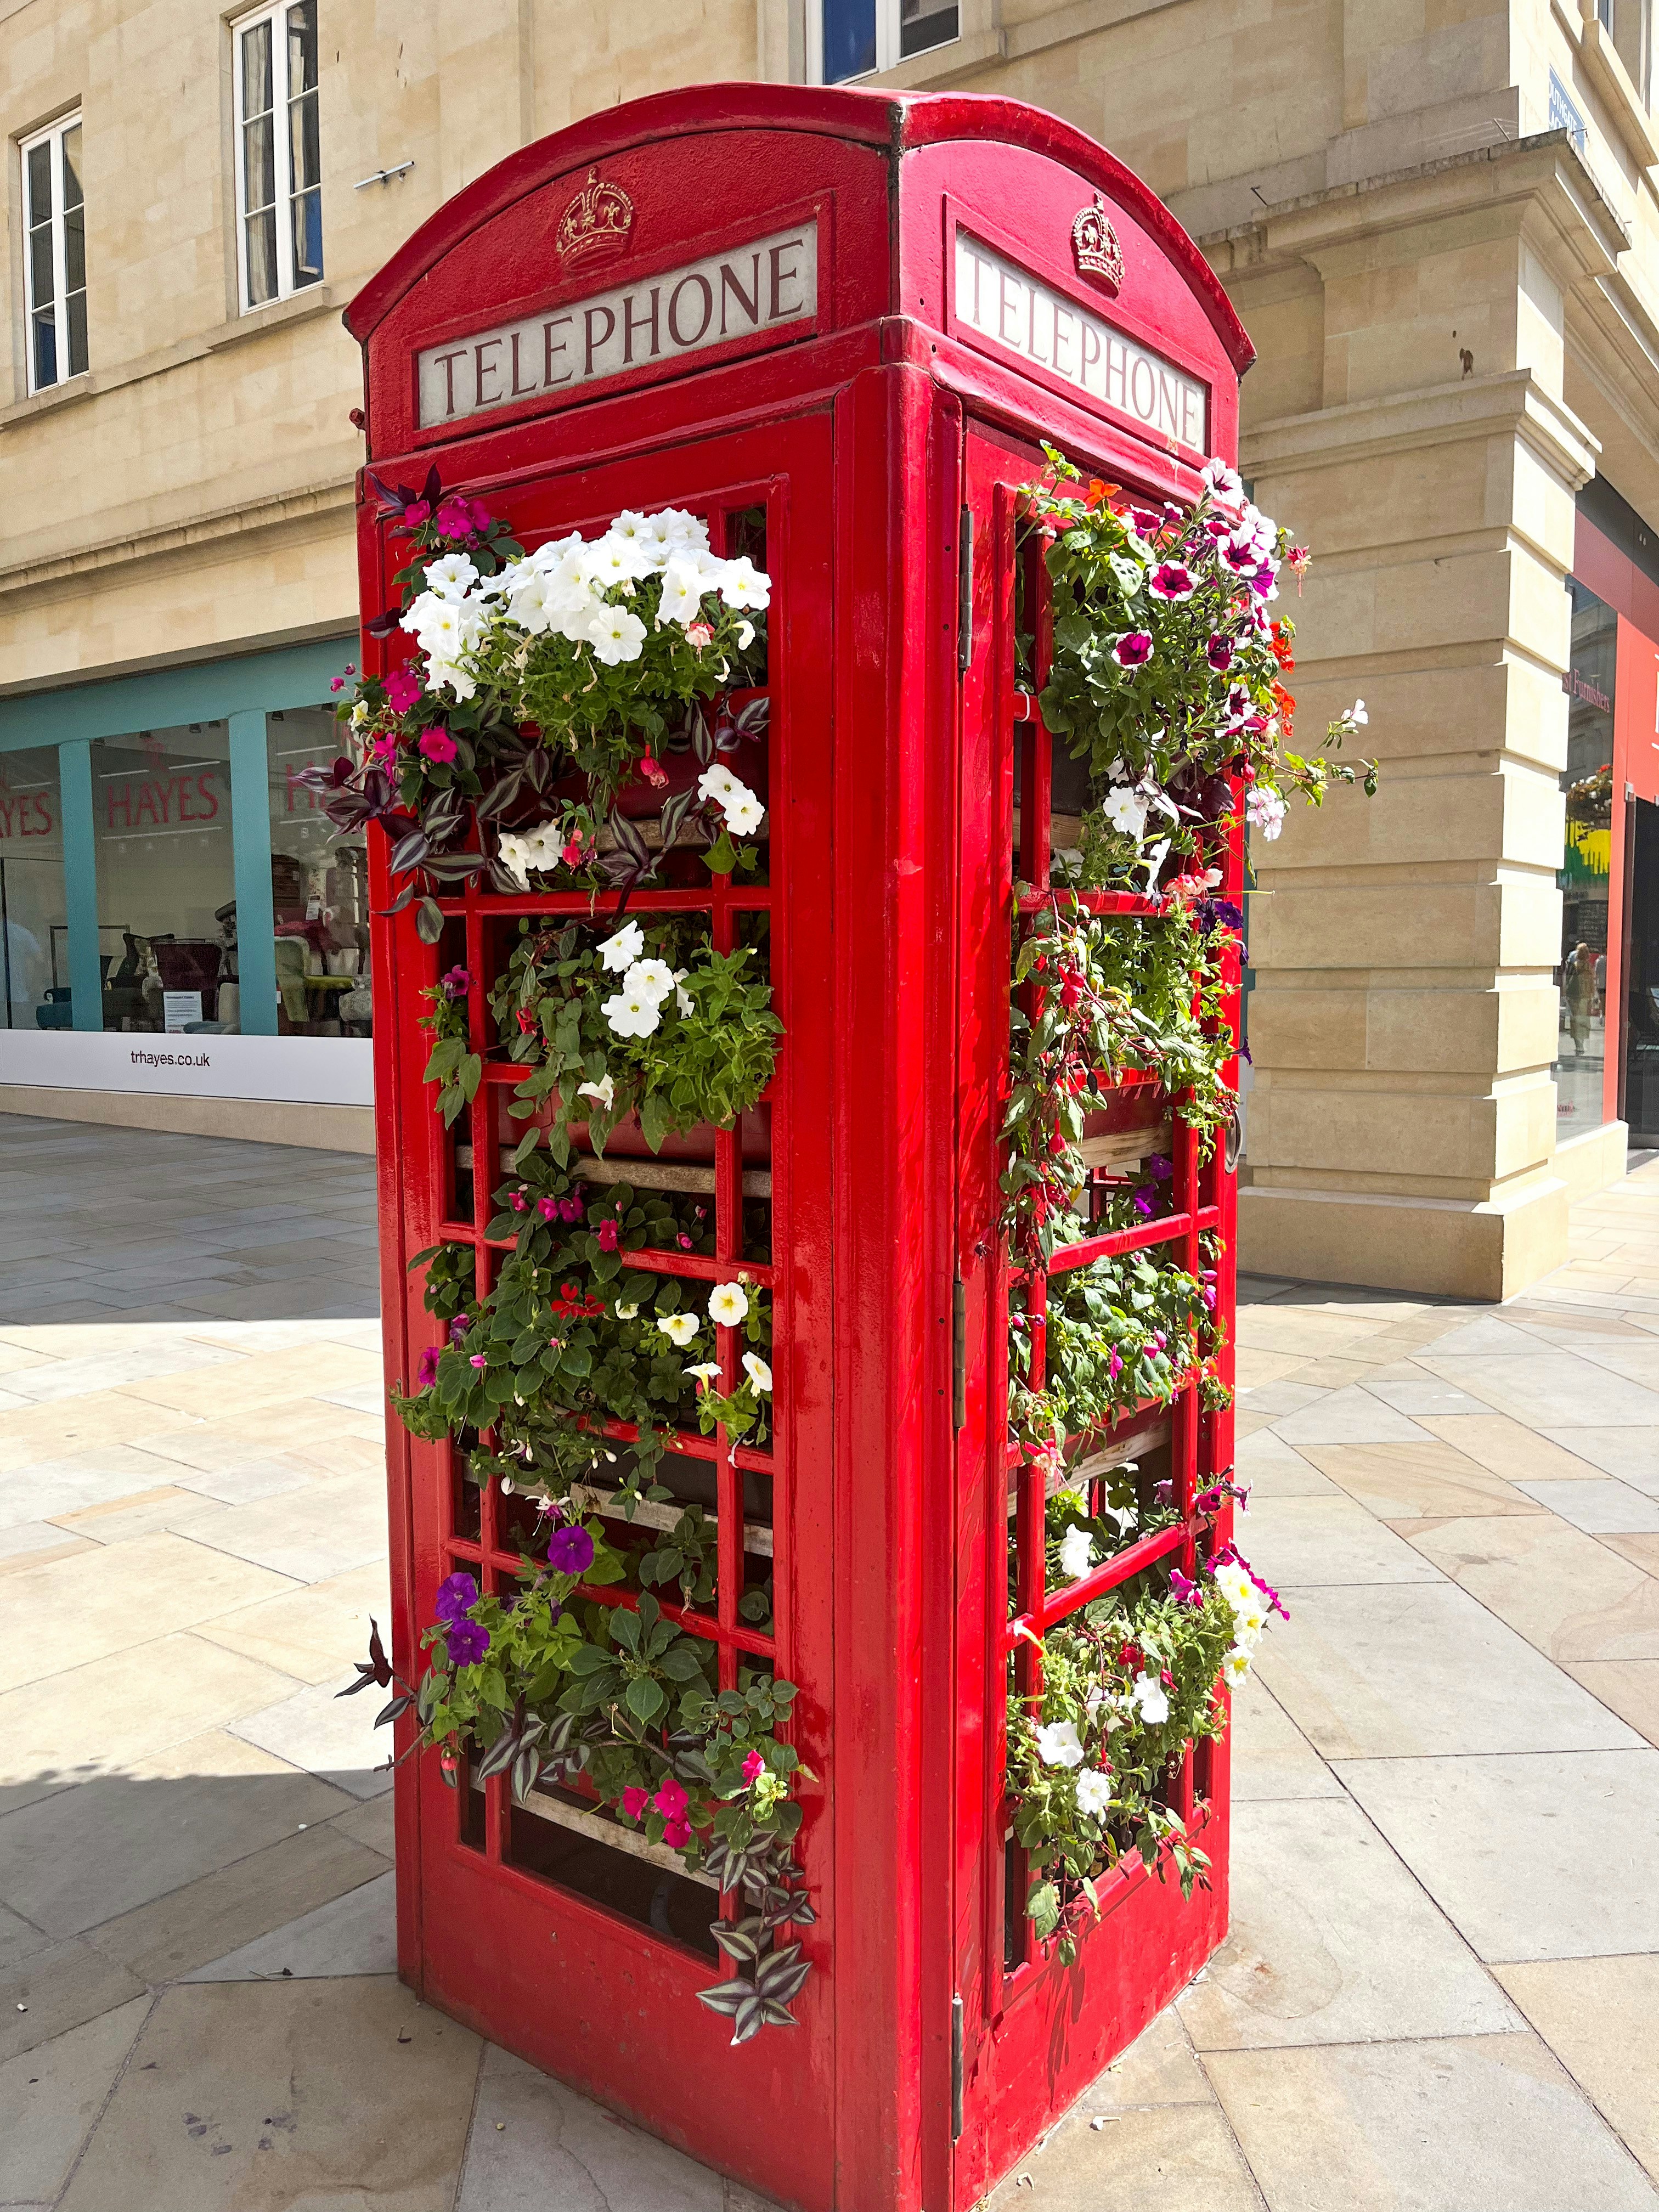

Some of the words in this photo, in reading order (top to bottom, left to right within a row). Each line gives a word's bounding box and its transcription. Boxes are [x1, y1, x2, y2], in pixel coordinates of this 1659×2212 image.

[434, 239, 804, 416] TELEPHONE
[963, 244, 1199, 447] TELEPHONE
[0, 792, 52, 838] YES
[106, 772, 219, 828] HAYES
[131, 1050, 210, 1068] trhayes.co.uk
